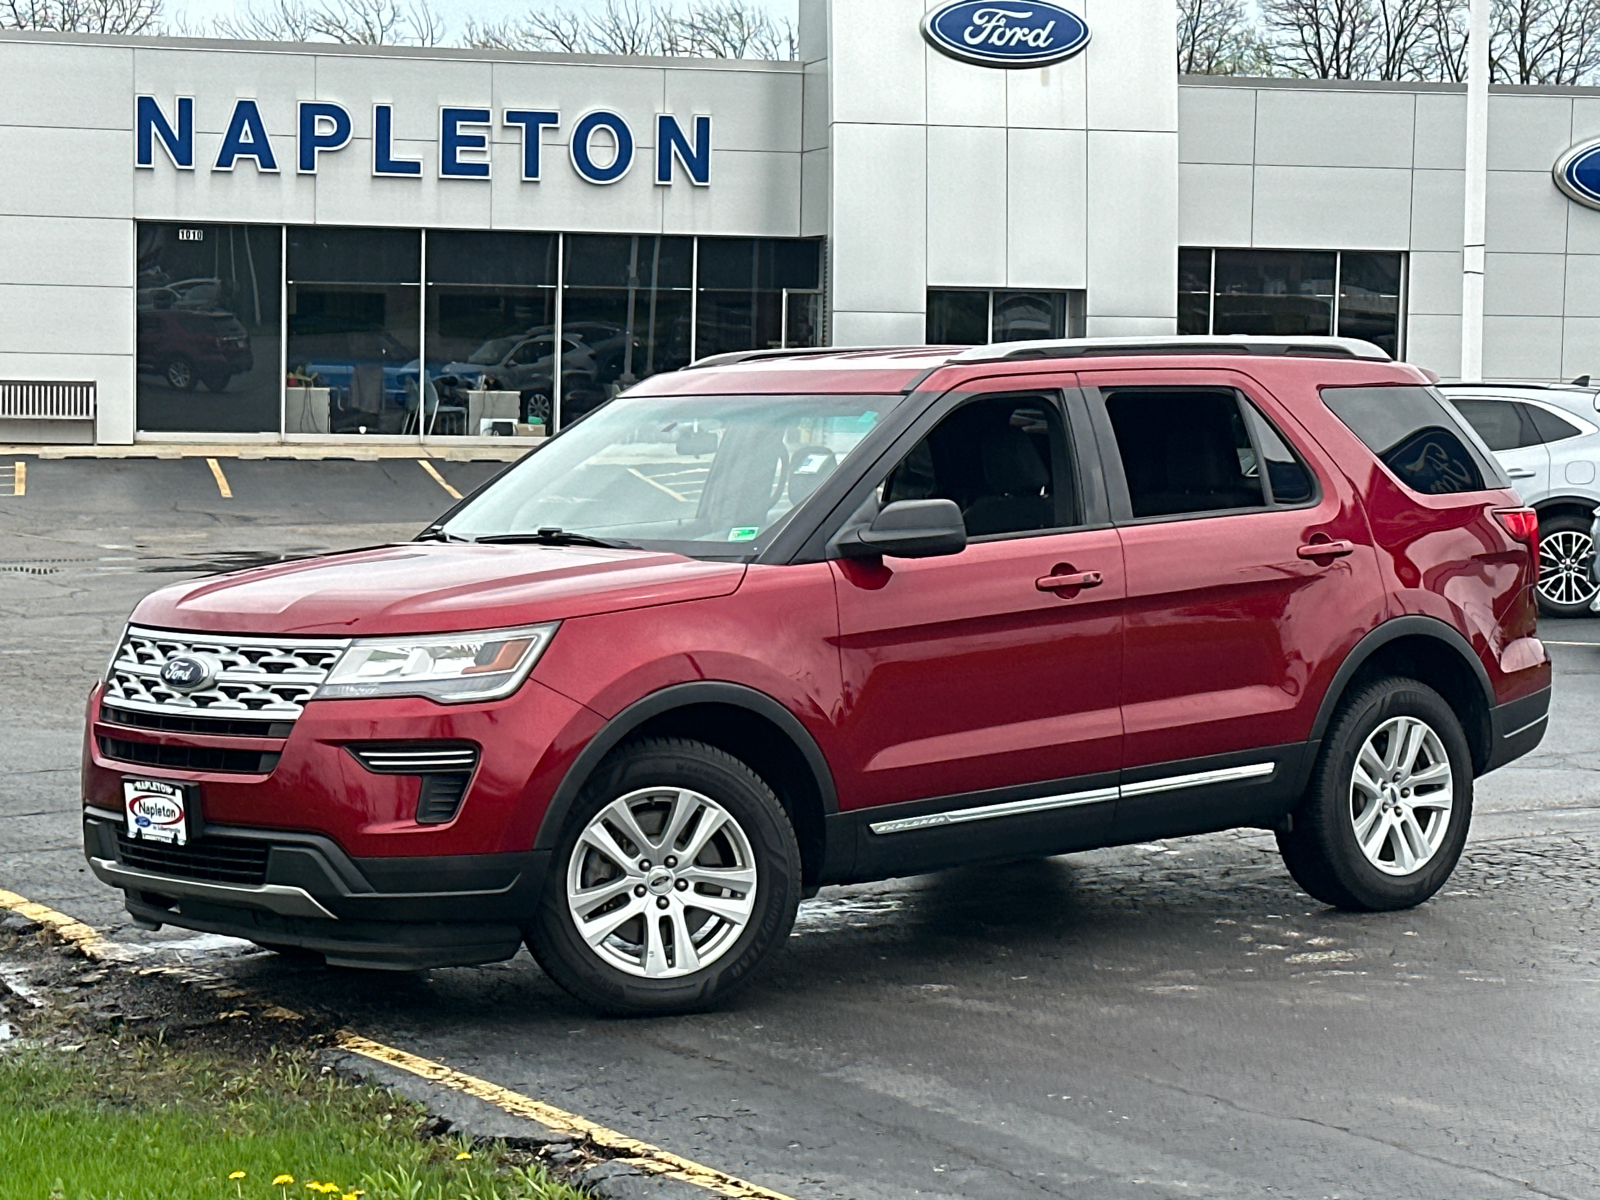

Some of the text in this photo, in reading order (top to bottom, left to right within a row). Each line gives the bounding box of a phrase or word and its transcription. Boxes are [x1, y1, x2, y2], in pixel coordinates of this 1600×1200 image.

[963, 8, 1056, 48] Ford
[134, 94, 712, 187] NAPLETON
[180, 229, 203, 240] 1010
[165, 661, 194, 681] Ford
[138, 800, 176, 819] Napleton
[876, 816, 946, 832] EXPLORER
